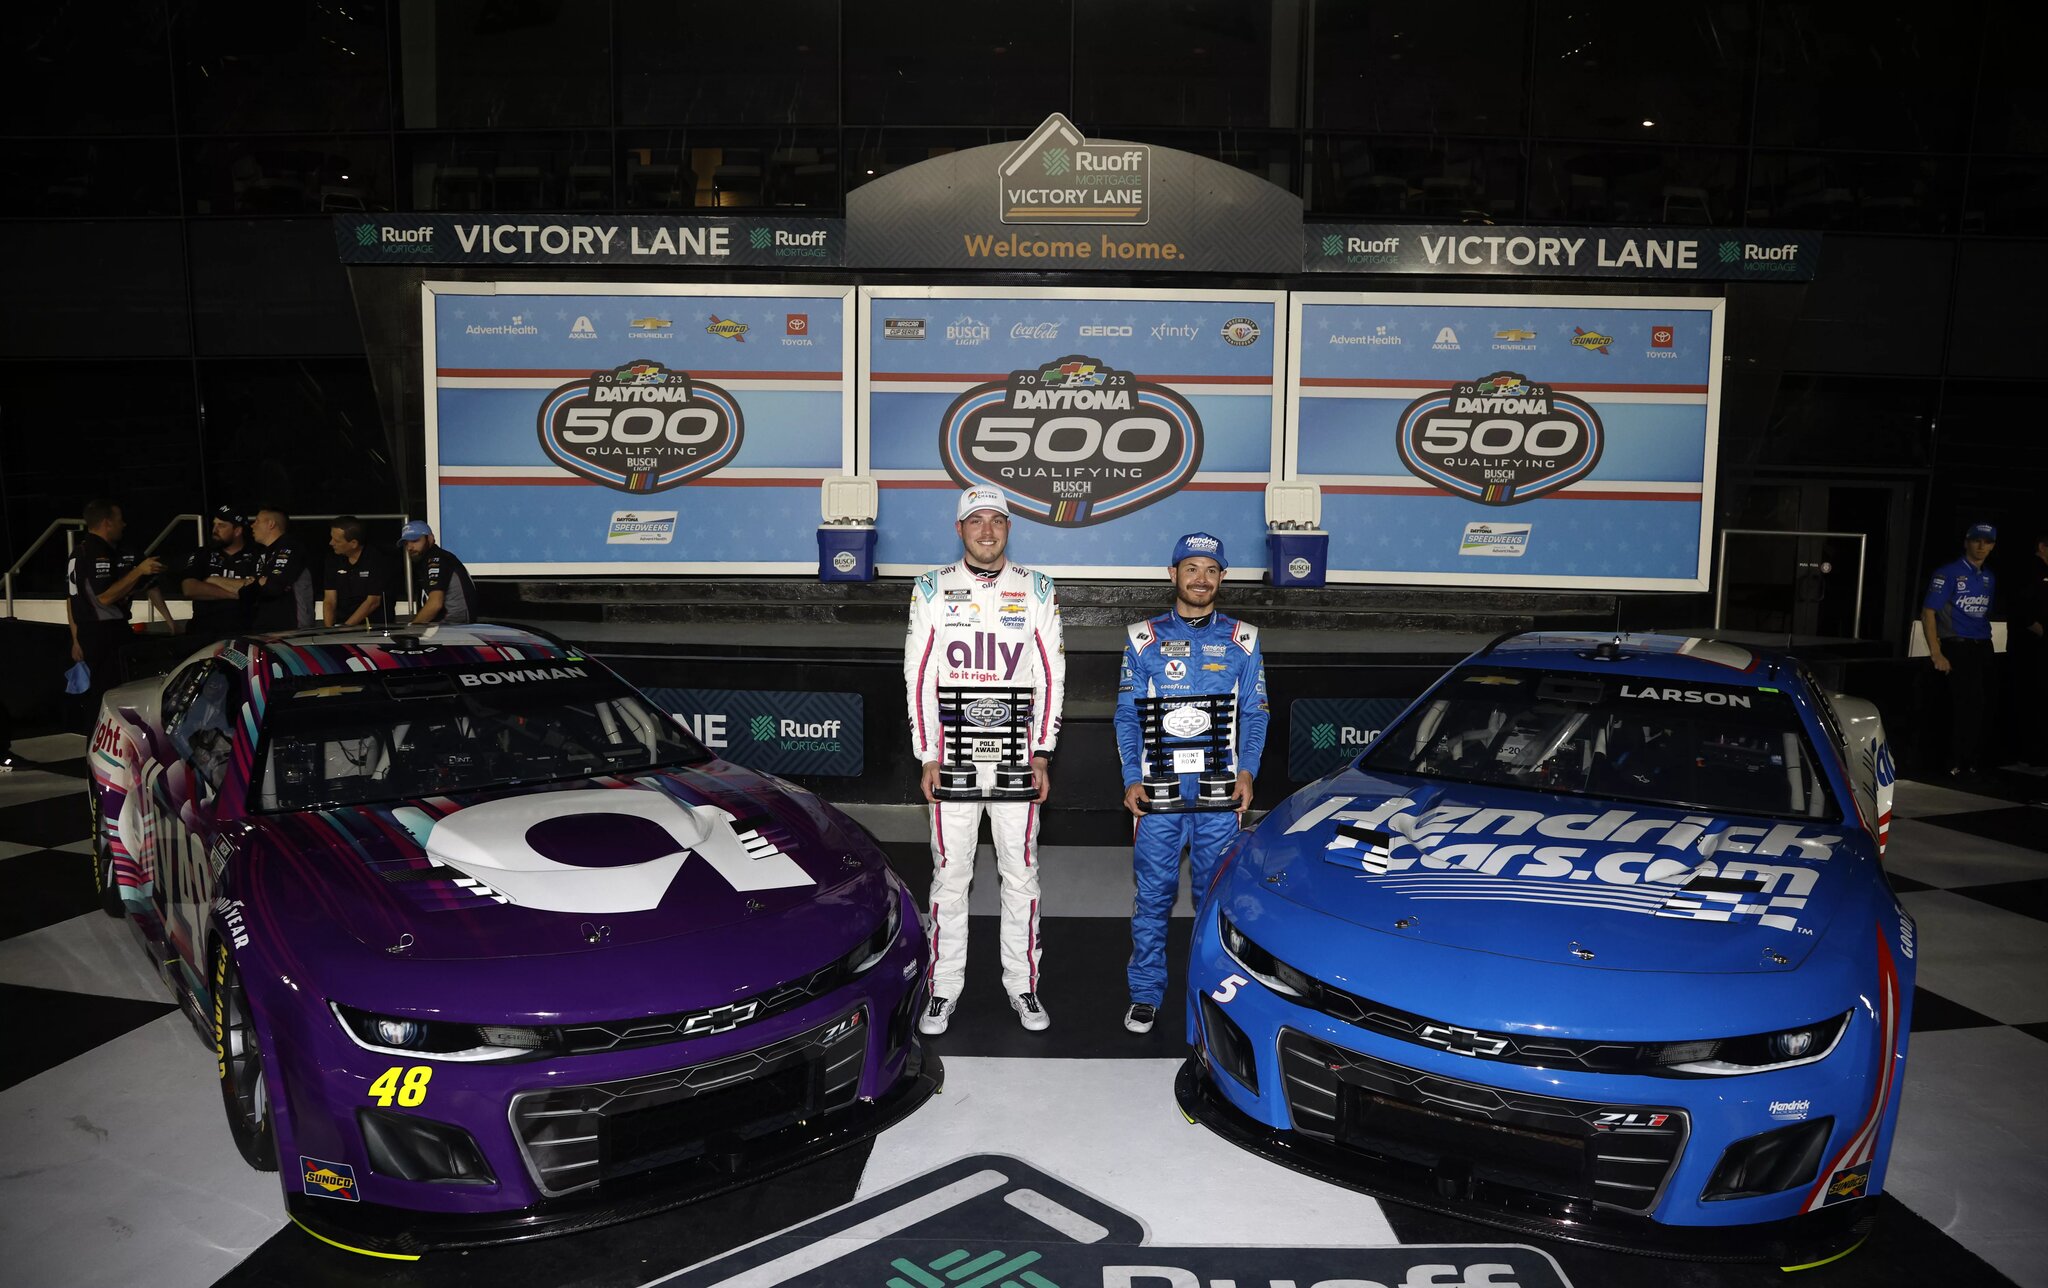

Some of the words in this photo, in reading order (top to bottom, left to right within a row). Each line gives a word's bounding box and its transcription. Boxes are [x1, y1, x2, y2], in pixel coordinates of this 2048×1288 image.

[1075, 151, 1142, 171] Ruoff
[1075, 175, 1142, 186] MORTGAGE
[1008, 189, 1088, 204] VICTORY
[1093, 189, 1142, 204] LANE
[382, 226, 434, 242] Ruoff
[454, 224, 619, 255] VICTORY
[631, 226, 730, 256] LANE
[775, 230, 827, 246] Ruoff
[382, 244, 433, 254] MORTGAGE
[963, 233, 1092, 258] Welcome
[1101, 234, 1185, 260] home.
[1347, 237, 1399, 253] Ruoff
[775, 248, 826, 257] MORTGAGE
[1420, 236, 1586, 266] VICTORY
[1597, 238, 1698, 269] LANE
[1744, 244, 1798, 260] Ruoff
[1347, 255, 1398, 264] MORTGAGE
[1744, 262, 1797, 272] MORTGAGE
[465, 325, 538, 335] AdventHealth
[708, 324, 747, 334] SUNOCO
[901, 328, 920, 336] SERIES
[946, 326, 990, 340] BUSCH
[1009, 321, 1062, 340] Coca-Cola
[1079, 326, 1133, 337] GEICO
[1151, 323, 1199, 341] xfinity
[1329, 334, 1401, 345] AdventHealth
[1573, 337, 1611, 345] SUNOCO
[1646, 351, 1677, 359] TOYOTA
[598, 375, 612, 383] 20
[670, 376, 683, 384] 23
[1018, 375, 1036, 385] 20
[1110, 376, 1126, 386] 23
[594, 386, 687, 403] DAYTONA
[1460, 386, 1474, 395] 20
[1531, 387, 1544, 396] 23
[1012, 389, 1132, 410] DAYTONA
[1454, 397, 1548, 415] DAYTONA
[562, 407, 719, 444] 500
[971, 417, 1171, 463] 500
[1421, 418, 1579, 457] 500
[585, 447, 697, 456] QUALIFYING
[627, 457, 658, 468] BUSCH
[1443, 457, 1556, 469] QUALIFYING
[1000, 467, 1143, 478] QUALIFYING
[1484, 469, 1515, 480] BUSCH
[1053, 481, 1092, 494] BUSCH
[614, 523, 669, 531] SPEEDWEEKS
[1185, 536, 1219, 547] Hendrick
[1467, 535, 1522, 544] SPEEDWEEKS
[834, 558, 855, 566] BUSCH
[1290, 564, 1310, 572] BUSCH
[940, 566, 956, 576] ally
[1012, 566, 1029, 578] ally
[1000, 591, 1027, 599] Hendrick
[1000, 616, 1026, 624] Hendrick
[1201, 643, 1228, 652] Hendrick
[946, 631, 1024, 681] ally
[458, 667, 589, 687] BOWMAN
[949, 670, 960, 679] do
[961, 670, 969, 680] it
[971, 672, 1000, 683] right.
[1160, 683, 1191, 691] GOODYEAR
[1620, 685, 1751, 709] LARSON
[970, 708, 1006, 717] 500
[780, 719, 841, 739] Ruoff
[780, 740, 841, 752] MORTGAGE
[1282, 796, 1843, 861] Hendrick
[1797, 926, 1813, 936] TM
[1211, 973, 1249, 1003] 5
[822, 1011, 861, 1044] ZL1
[367, 1065, 433, 1108] 48
[1768, 1099, 1811, 1113] Hendrick
[1594, 1112, 1670, 1128] ZL1
[307, 1172, 352, 1188] SUNOCO
[1830, 1174, 1867, 1194] SUNOCO
